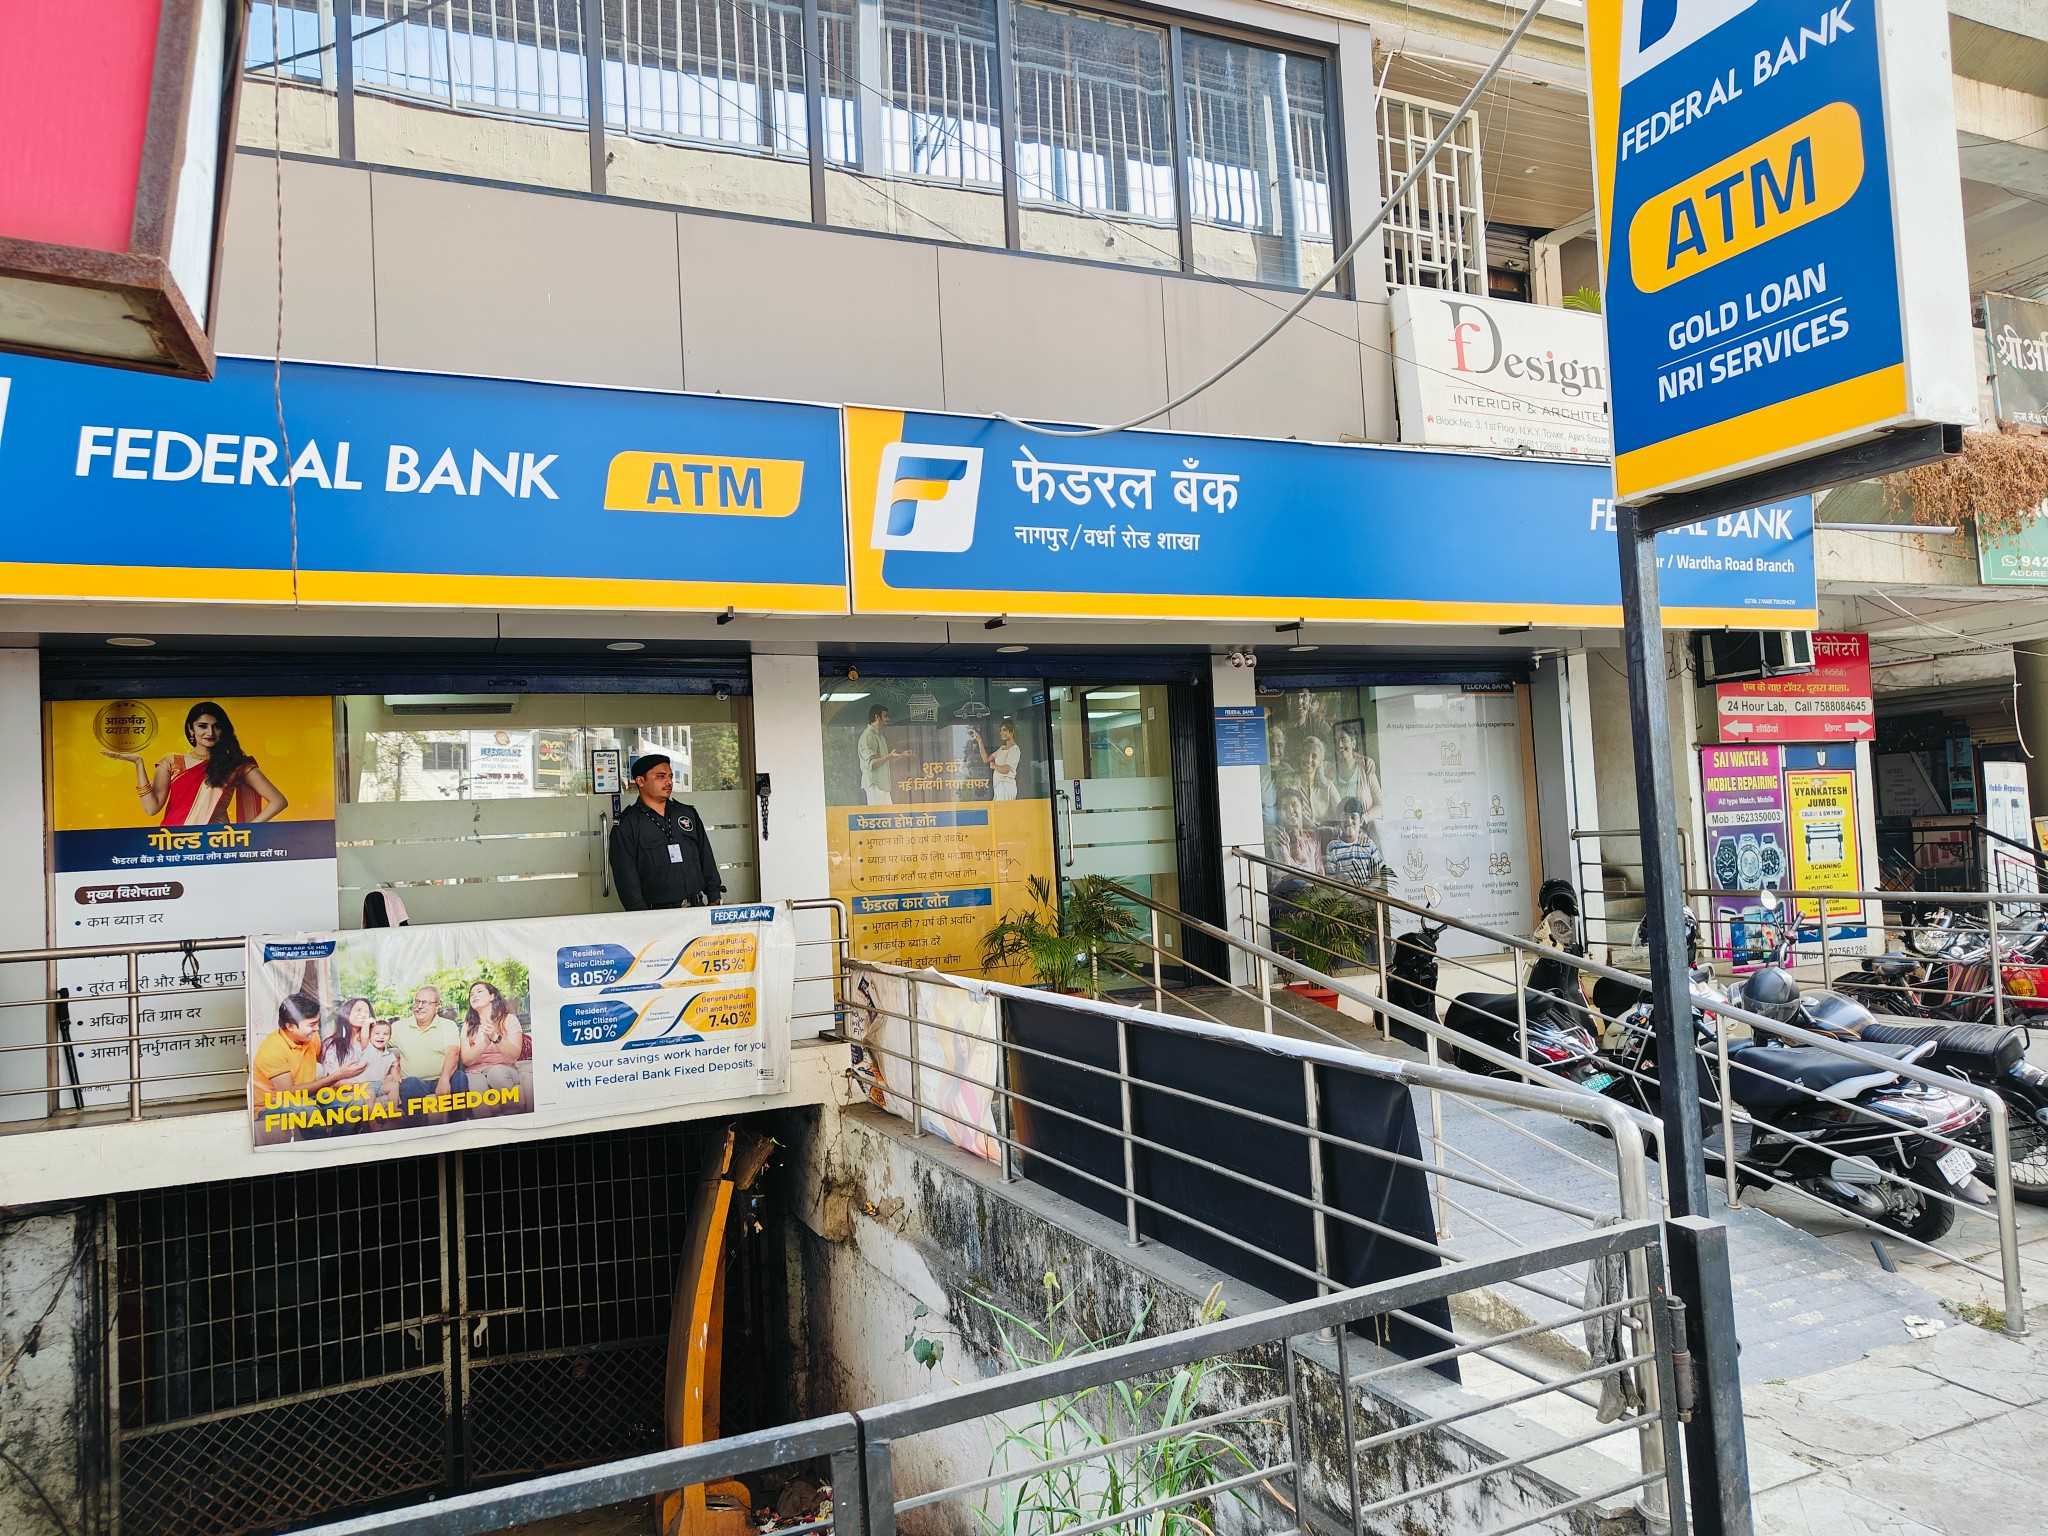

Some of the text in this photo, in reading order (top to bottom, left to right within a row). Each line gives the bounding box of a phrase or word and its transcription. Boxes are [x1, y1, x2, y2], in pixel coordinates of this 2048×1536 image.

[1622, 0, 1856, 162] FEDERAL BANK
[1667, 136, 1816, 270] ATM
[1669, 263, 1827, 350] GOLD LOAN
[1440, 300, 1606, 397] Design
[1658, 308, 1849, 402] NRI SERVICES
[1453, 394, 1609, 423] INTERIOR & ARCHITEC
[1436, 416, 1458, 427] Block
[75, 425, 560, 500] FEDERAL BANK
[645, 461, 764, 509] ATM
[1011, 444, 1156, 510] फेडरल
[1716, 508, 1793, 541] BANK
[1122, 525, 1151, 549] रोड
[1157, 530, 1201, 551] शाखा
[1677, 554, 1722, 570] Wardha
[1725, 556, 1753, 572] Road
[1756, 558, 1795, 574] Branch
[2021, 555, 2048, 568] 942
[2010, 569, 2048, 578] ADDRE
[1728, 701, 1739, 712] 24
[1742, 701, 1764, 712] Hour
[1795, 701, 1812, 712] Call
[1815, 701, 1866, 712] 7588084645
[105, 715, 146, 726] आकर्षक
[133, 726, 146, 736] दर
[1713, 750, 1769, 768] SAI WATCH &
[1708, 776, 1737, 792] MOBILE
[1737, 775, 1778, 791] REPAIRING
[1794, 786, 1848, 797] VYANKATESH
[1807, 798, 1837, 808] JUMBO
[856, 812, 937, 829] फेडरल होम लोन
[1712, 814, 1729, 825] Mob
[147, 825, 252, 851] गोल्ड लोन
[112, 855, 138, 866] फेडरल
[140, 855, 155, 865] बैंक
[157, 854, 164, 863] से
[206, 851, 222, 861] लोन
[223, 852, 238, 860] कम
[239, 850, 259, 859] ब्याज
[1810, 863, 1842, 871] SCANNING
[87, 882, 171, 904] मुख्य विशेषताएं
[861, 892, 949, 912] फेडरल कार लोन
[87, 912, 164, 928] कम ब्याज दर
[714, 909, 771, 921] FEDERAL BANK
[871, 920, 899, 934] भुगतान
[901, 917, 913, 930] की
[914, 920, 920, 928] 7
[936, 915, 948, 926] की
[698, 937, 747, 948] General Public
[872, 940, 906, 952] आकर्षक
[908, 938, 928, 948] ब्याज
[572, 948, 605, 958] Resident
[564, 959, 615, 969] Senior Citizen
[88, 981, 115, 995] तुरंत
[154, 974, 175, 988] और
[214, 970, 238, 985] मुक्त
[701, 992, 749, 1003] General Public
[709, 1000, 754, 1012] and Resident)
[89, 1007, 202, 1028] अधिक ग्राम दर
[575, 1006, 608, 1016] Resident
[567, 1017, 618, 1027] Senior Citizen
[90, 1034, 215, 1059] आसान और
[552, 1041, 767, 1073] Make your savings work harder for you
[565, 1076, 592, 1089] with
[595, 1071, 639, 1086] Federal
[642, 1067, 671, 1081] Bank
[674, 1063, 705, 1077] Fixed
[264, 1082, 370, 1110] UNLOCK
[265, 1086, 520, 1132] FINANCIAL FREEDOM
